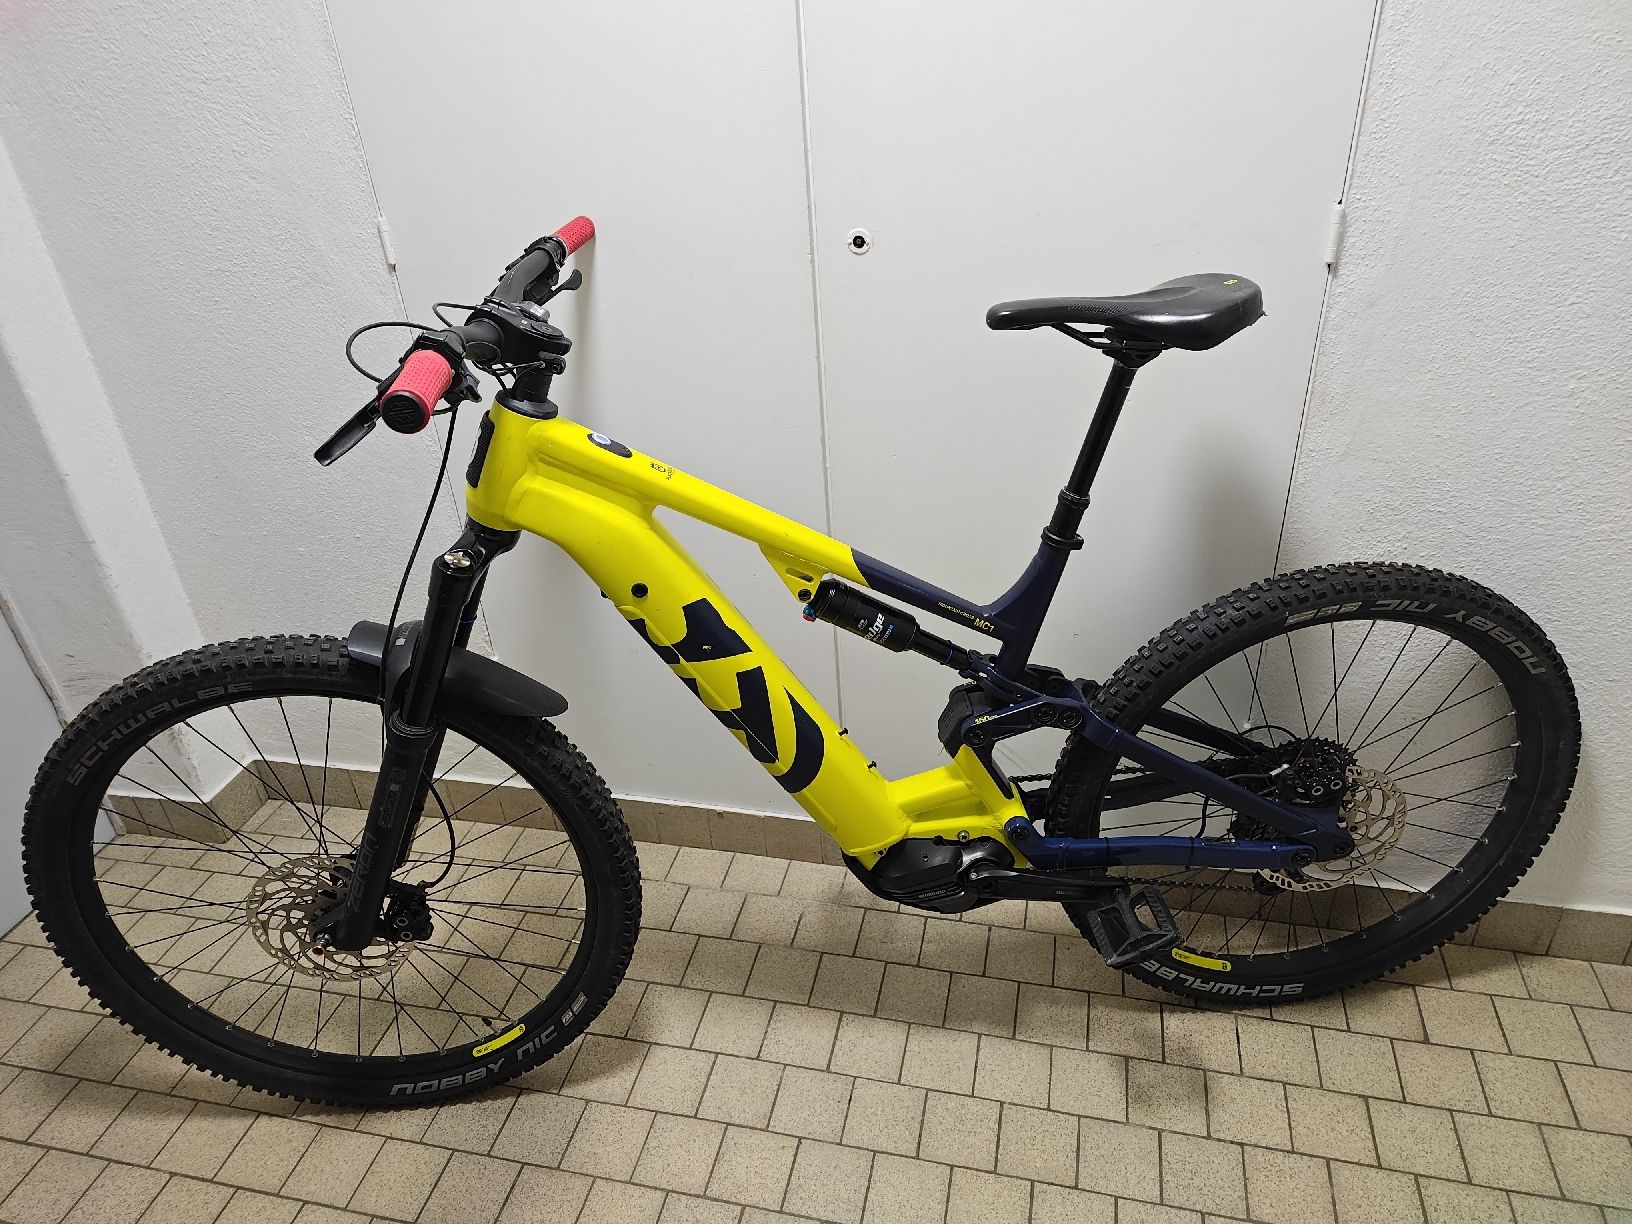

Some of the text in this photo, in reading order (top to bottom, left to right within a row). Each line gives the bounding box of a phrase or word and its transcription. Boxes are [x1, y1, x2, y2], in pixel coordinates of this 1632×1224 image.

[973, 617, 995, 632] MC1
[1370, 599, 1547, 674] NOBBY NIC
[66, 681, 253, 786] SCHWALBE
[1139, 960, 1305, 997] SCHWALBE
[389, 1024, 558, 1096] NOBBY NIC
